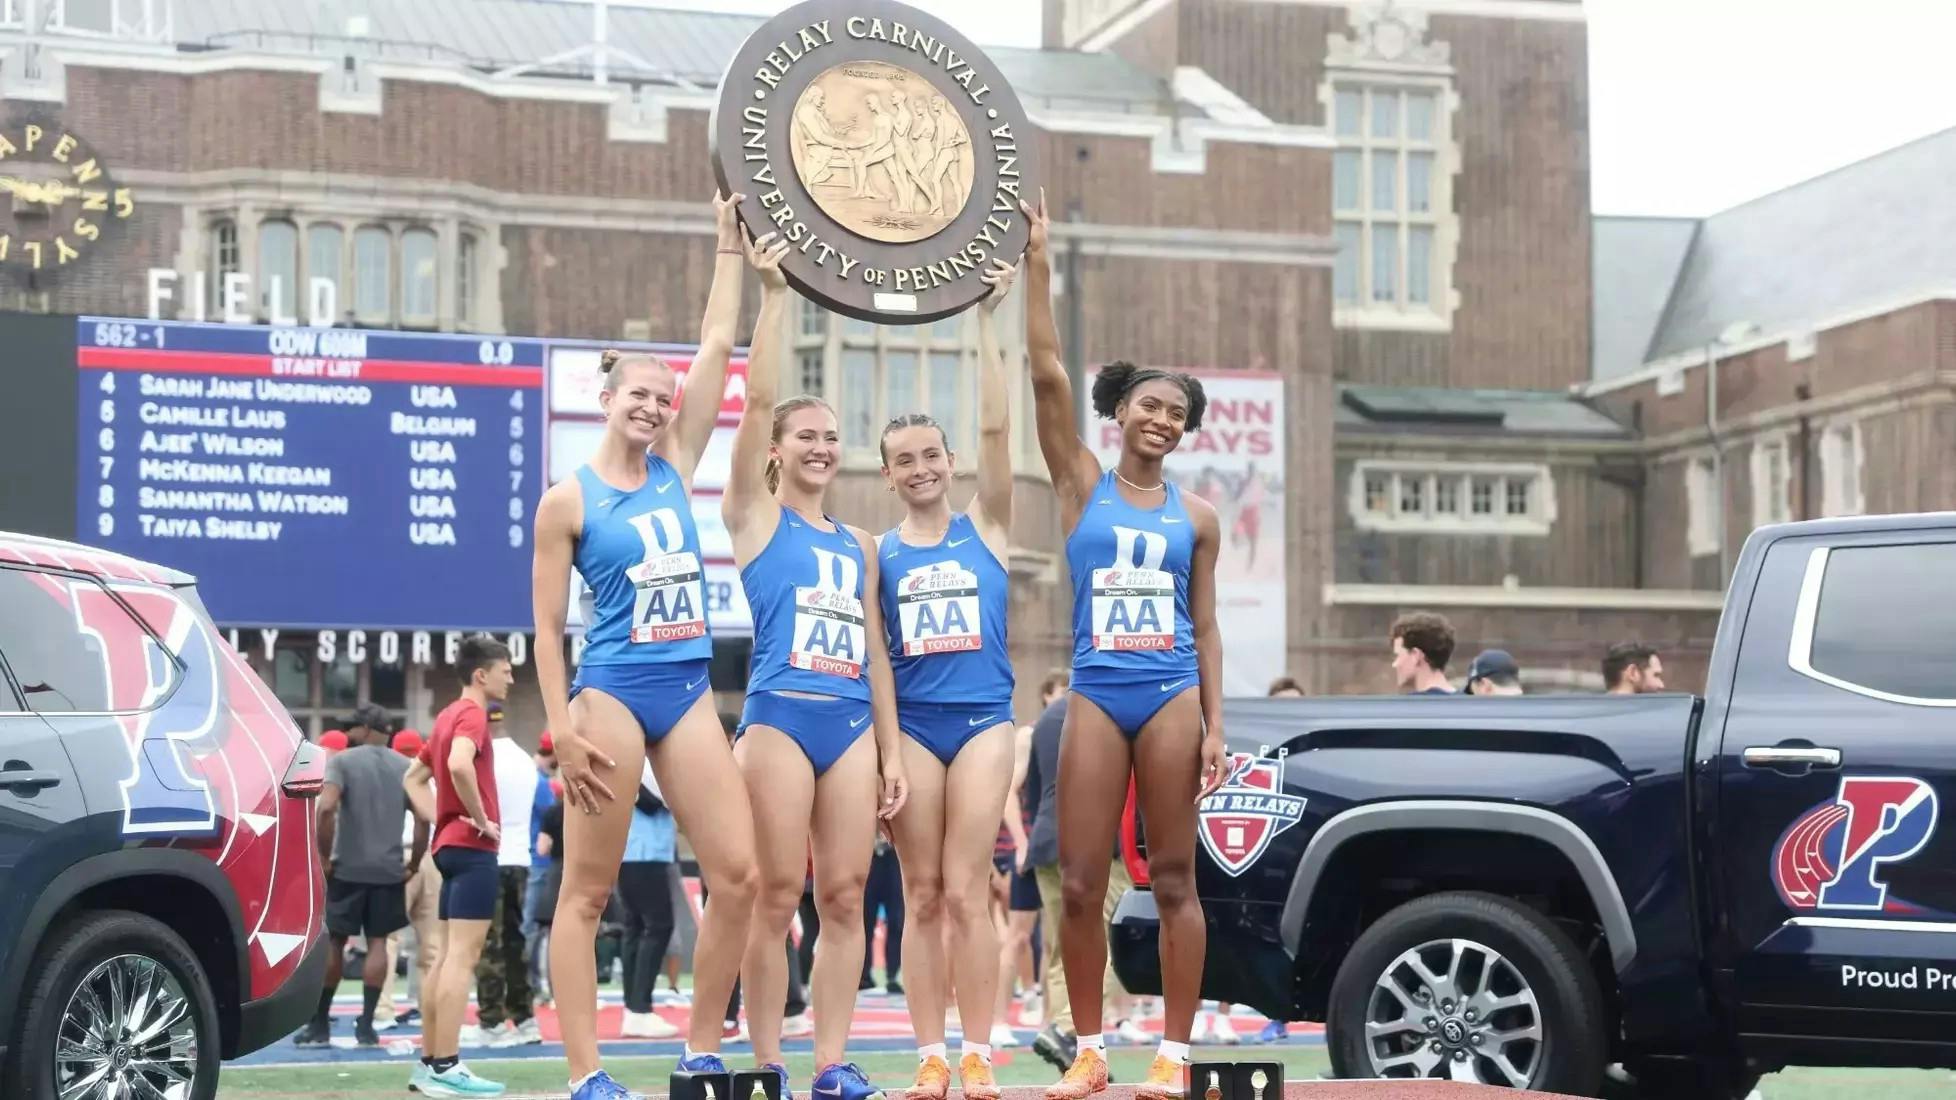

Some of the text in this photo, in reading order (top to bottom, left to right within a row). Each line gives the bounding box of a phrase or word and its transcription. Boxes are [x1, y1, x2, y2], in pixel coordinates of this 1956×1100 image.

[755, 16, 990, 105] RELAY CARNIVAL
[115, 188, 133, 217] 5
[743, 106, 1019, 291] UNIVERSITY OF PENNSYLVANIA
[148, 268, 336, 327] FIELD
[100, 371, 524, 410] 4 SARAH JANE UNDERWOOD USA 4
[100, 401, 524, 438] 5 CAMILLE LAUS BELGIUM 5
[1203, 399, 1273, 425] NN
[100, 429, 114, 451] 6
[203, 434, 284, 457] WILSON
[411, 440, 456, 463] USA
[1101, 426, 1274, 456] RAYS
[100, 457, 114, 479] 7
[248, 463, 331, 486] KEEGAN
[410, 468, 456, 491] USA
[509, 472, 524, 492] 7
[100, 485, 114, 508] 8
[139, 486, 254, 512] SAMANTHA
[257, 491, 349, 516] WATSON
[410, 494, 456, 519] USA
[100, 513, 524, 549] 9 TAIYA SHELBY USA 9
[643, 586, 695, 625] AA
[914, 600, 969, 638] AA
[1105, 599, 1162, 632] AA
[654, 625, 698, 638] TOYOTA
[804, 619, 853, 660] AA
[927, 638, 974, 650] TOYOTA
[1118, 637, 1166, 648] TOYOTA
[815, 660, 853, 674] TOYOTA
[1200, 795, 1300, 816] NN RELAYS
[1842, 965, 1918, 989] Proud
